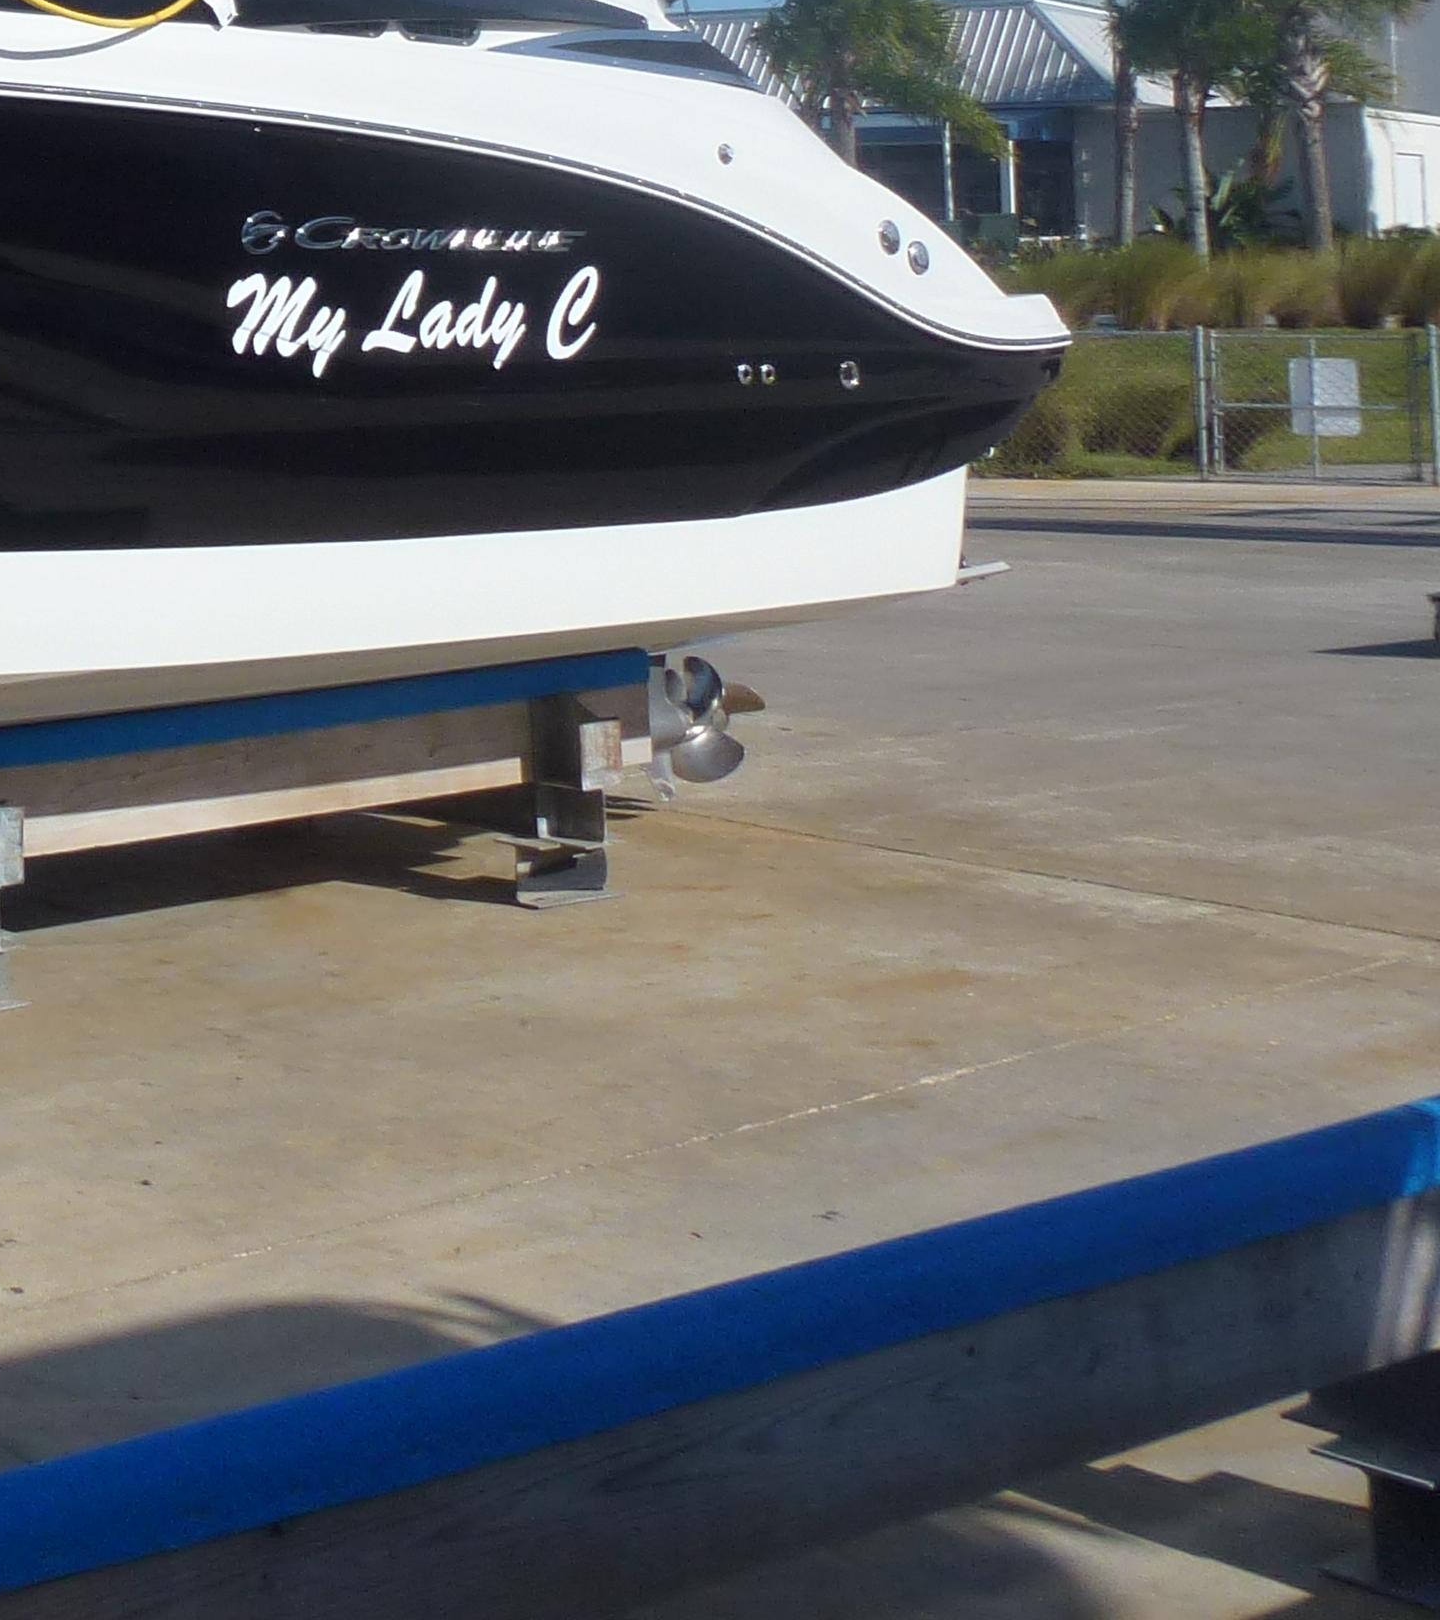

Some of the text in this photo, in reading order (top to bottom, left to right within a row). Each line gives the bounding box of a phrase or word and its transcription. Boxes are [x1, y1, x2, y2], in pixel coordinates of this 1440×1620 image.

[226, 265, 599, 378] My Lady C
